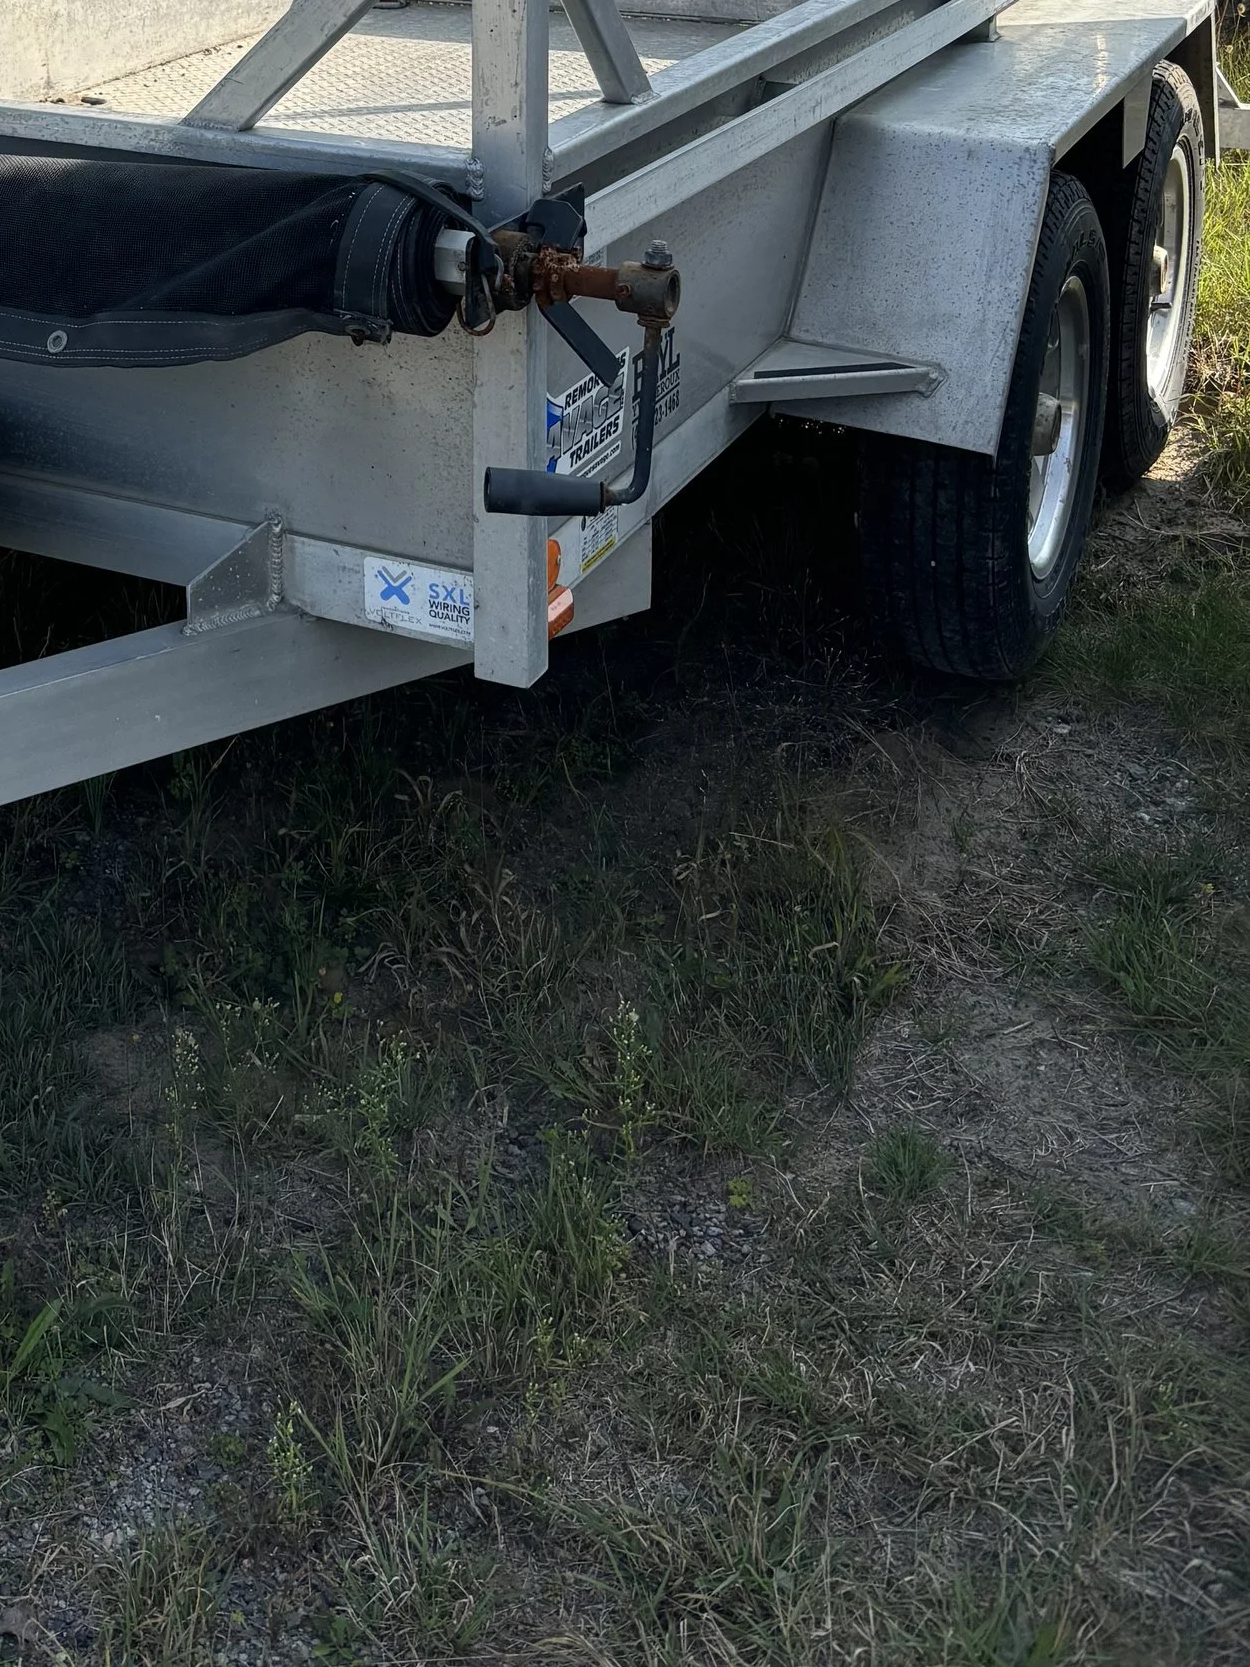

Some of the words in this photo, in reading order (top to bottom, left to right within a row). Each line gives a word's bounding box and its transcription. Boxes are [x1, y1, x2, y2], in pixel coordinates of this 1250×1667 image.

[547, 371, 625, 461] AVAGE
[569, 415, 621, 468] TRAILERS
[429, 582, 470, 606] SXL
[369, 608, 423, 625] VOLTFLEX
[429, 599, 470, 616] WIRING
[429, 610, 470, 624] QUALITY
